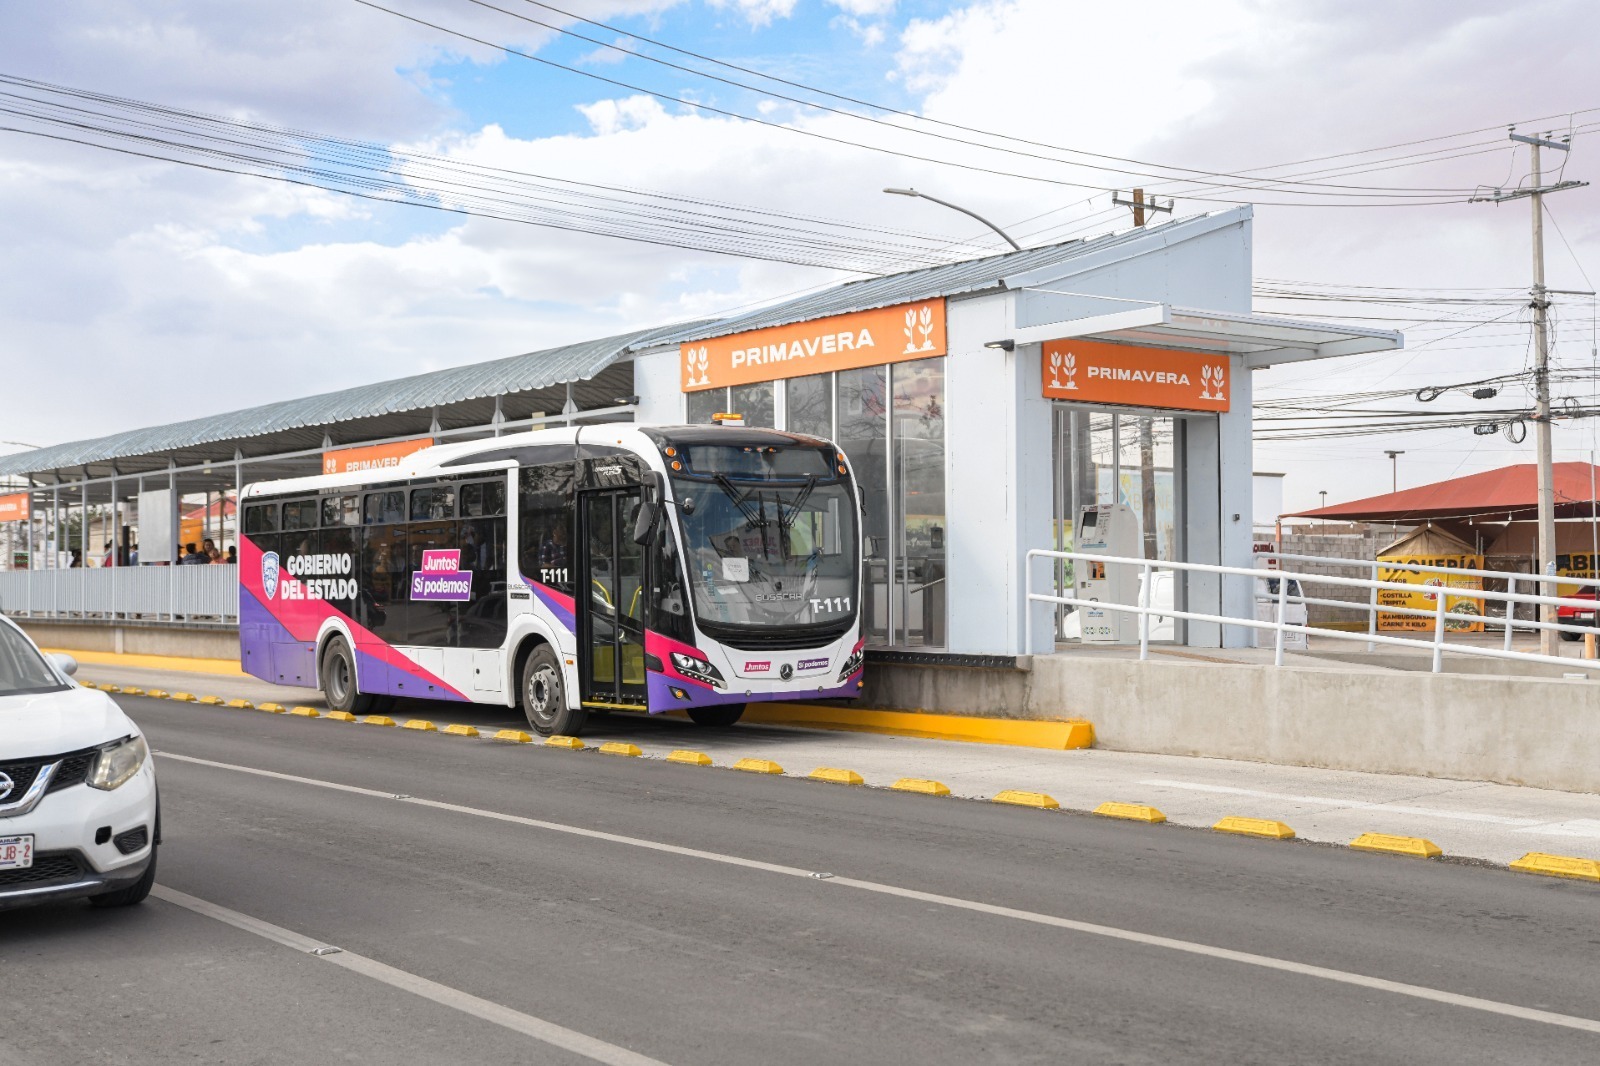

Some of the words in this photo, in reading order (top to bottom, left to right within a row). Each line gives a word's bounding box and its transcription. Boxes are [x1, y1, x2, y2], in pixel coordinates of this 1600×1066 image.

[732, 328, 875, 368] PRIMAVERA
[1087, 366, 1190, 385] PRIMAVERA
[346, 456, 404, 472] PRIMAVER
[287, 553, 351, 575] GOBIERNO
[424, 556, 457, 571] Juntos
[540, 568, 568, 583] T-111
[281, 580, 304, 600] DEL
[307, 578, 358, 600] ESTADO
[413, 577, 424, 593] Sí
[424, 578, 469, 596] podemos
[756, 593, 804, 601] BUSSCAR
[810, 597, 851, 613] T-111
[746, 663, 769, 671] Juntos
[804, 659, 828, 669] podemos
